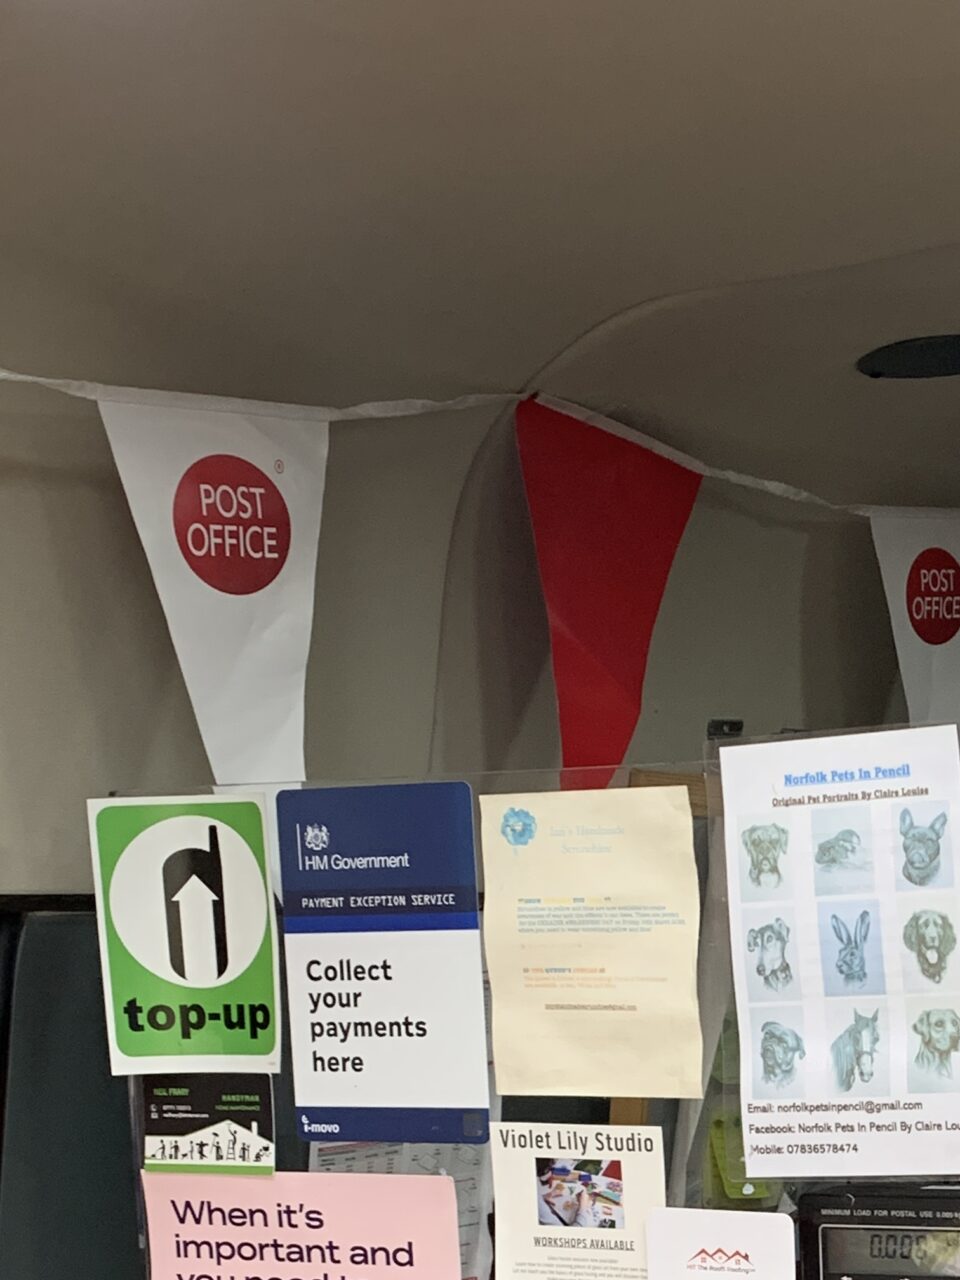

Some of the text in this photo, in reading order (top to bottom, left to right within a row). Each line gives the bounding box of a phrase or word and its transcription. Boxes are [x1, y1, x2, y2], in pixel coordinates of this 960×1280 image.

[200, 484, 265, 519] POST
[187, 522, 279, 559] OFFICE
[920, 569, 956, 592] POST
[912, 596, 960, 620] OFFICE
[784, 764, 911, 788] Norfolk Pets In Pencil
[772, 786, 930, 808] Original Pet Portraits By Claire Louise
[305, 852, 410, 870] HM Government
[302, 893, 456, 908] PAYMENT EXCEPTION SERVICE
[306, 959, 393, 982] Collect
[308, 988, 362, 1014] your
[123, 997, 270, 1039] top-up
[310, 1015, 428, 1043] payments
[312, 1050, 365, 1073] here
[747, 1101, 923, 1115] Email: norfolkpetsinpencil@gmail.com
[749, 1123, 796, 1134] Facebook:
[798, 1122, 832, 1133] Norfolk
[835, 1122, 856, 1133] Pets
[857, 1122, 867, 1133] In
[869, 1122, 898, 1132] Pencil
[900, 1122, 912, 1134] By
[915, 1121, 943, 1132] Claire
[499, 1129, 654, 1156] Violet Lily Studio
[750, 1144, 859, 1156] Mobile: 07836578474
[170, 1199, 324, 1229] When it's
[821, 1209, 851, 1217] MINIMUM
[853, 1209, 871, 1217] LOAD
[874, 1209, 889, 1217] FOR
[891, 1210, 917, 1218] POSTAL
[919, 1210, 933, 1218] USE
[175, 1234, 415, 1267] important and
[533, 1236, 636, 1251] WORKSHOPS AVAILABLE
